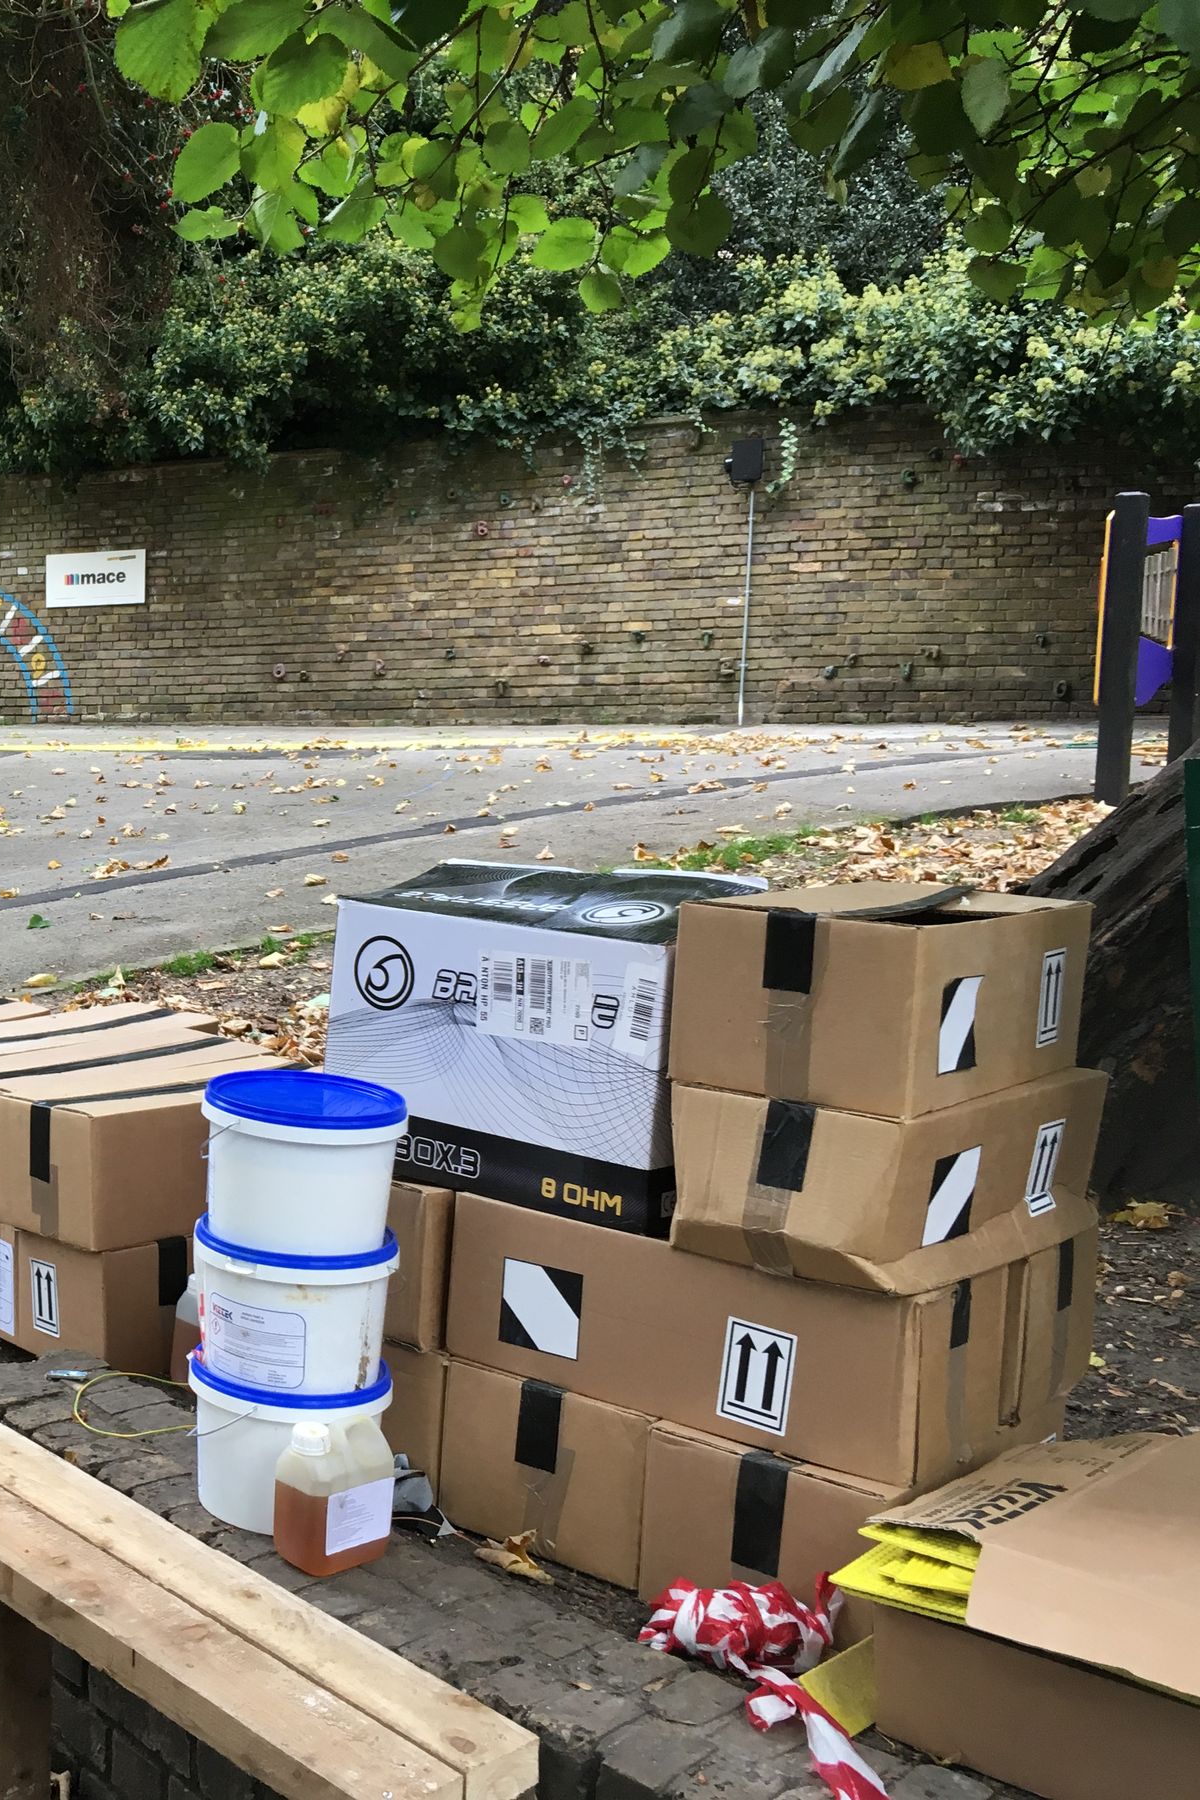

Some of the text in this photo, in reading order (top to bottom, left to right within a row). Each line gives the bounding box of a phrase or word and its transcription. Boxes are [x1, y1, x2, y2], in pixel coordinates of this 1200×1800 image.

[80, 571, 127, 585] mace
[479, 1011, 488, 1022] 55
[541, 1177, 623, 1217] 8 OHM
[212, 1302, 233, 1321] VIZTEK
